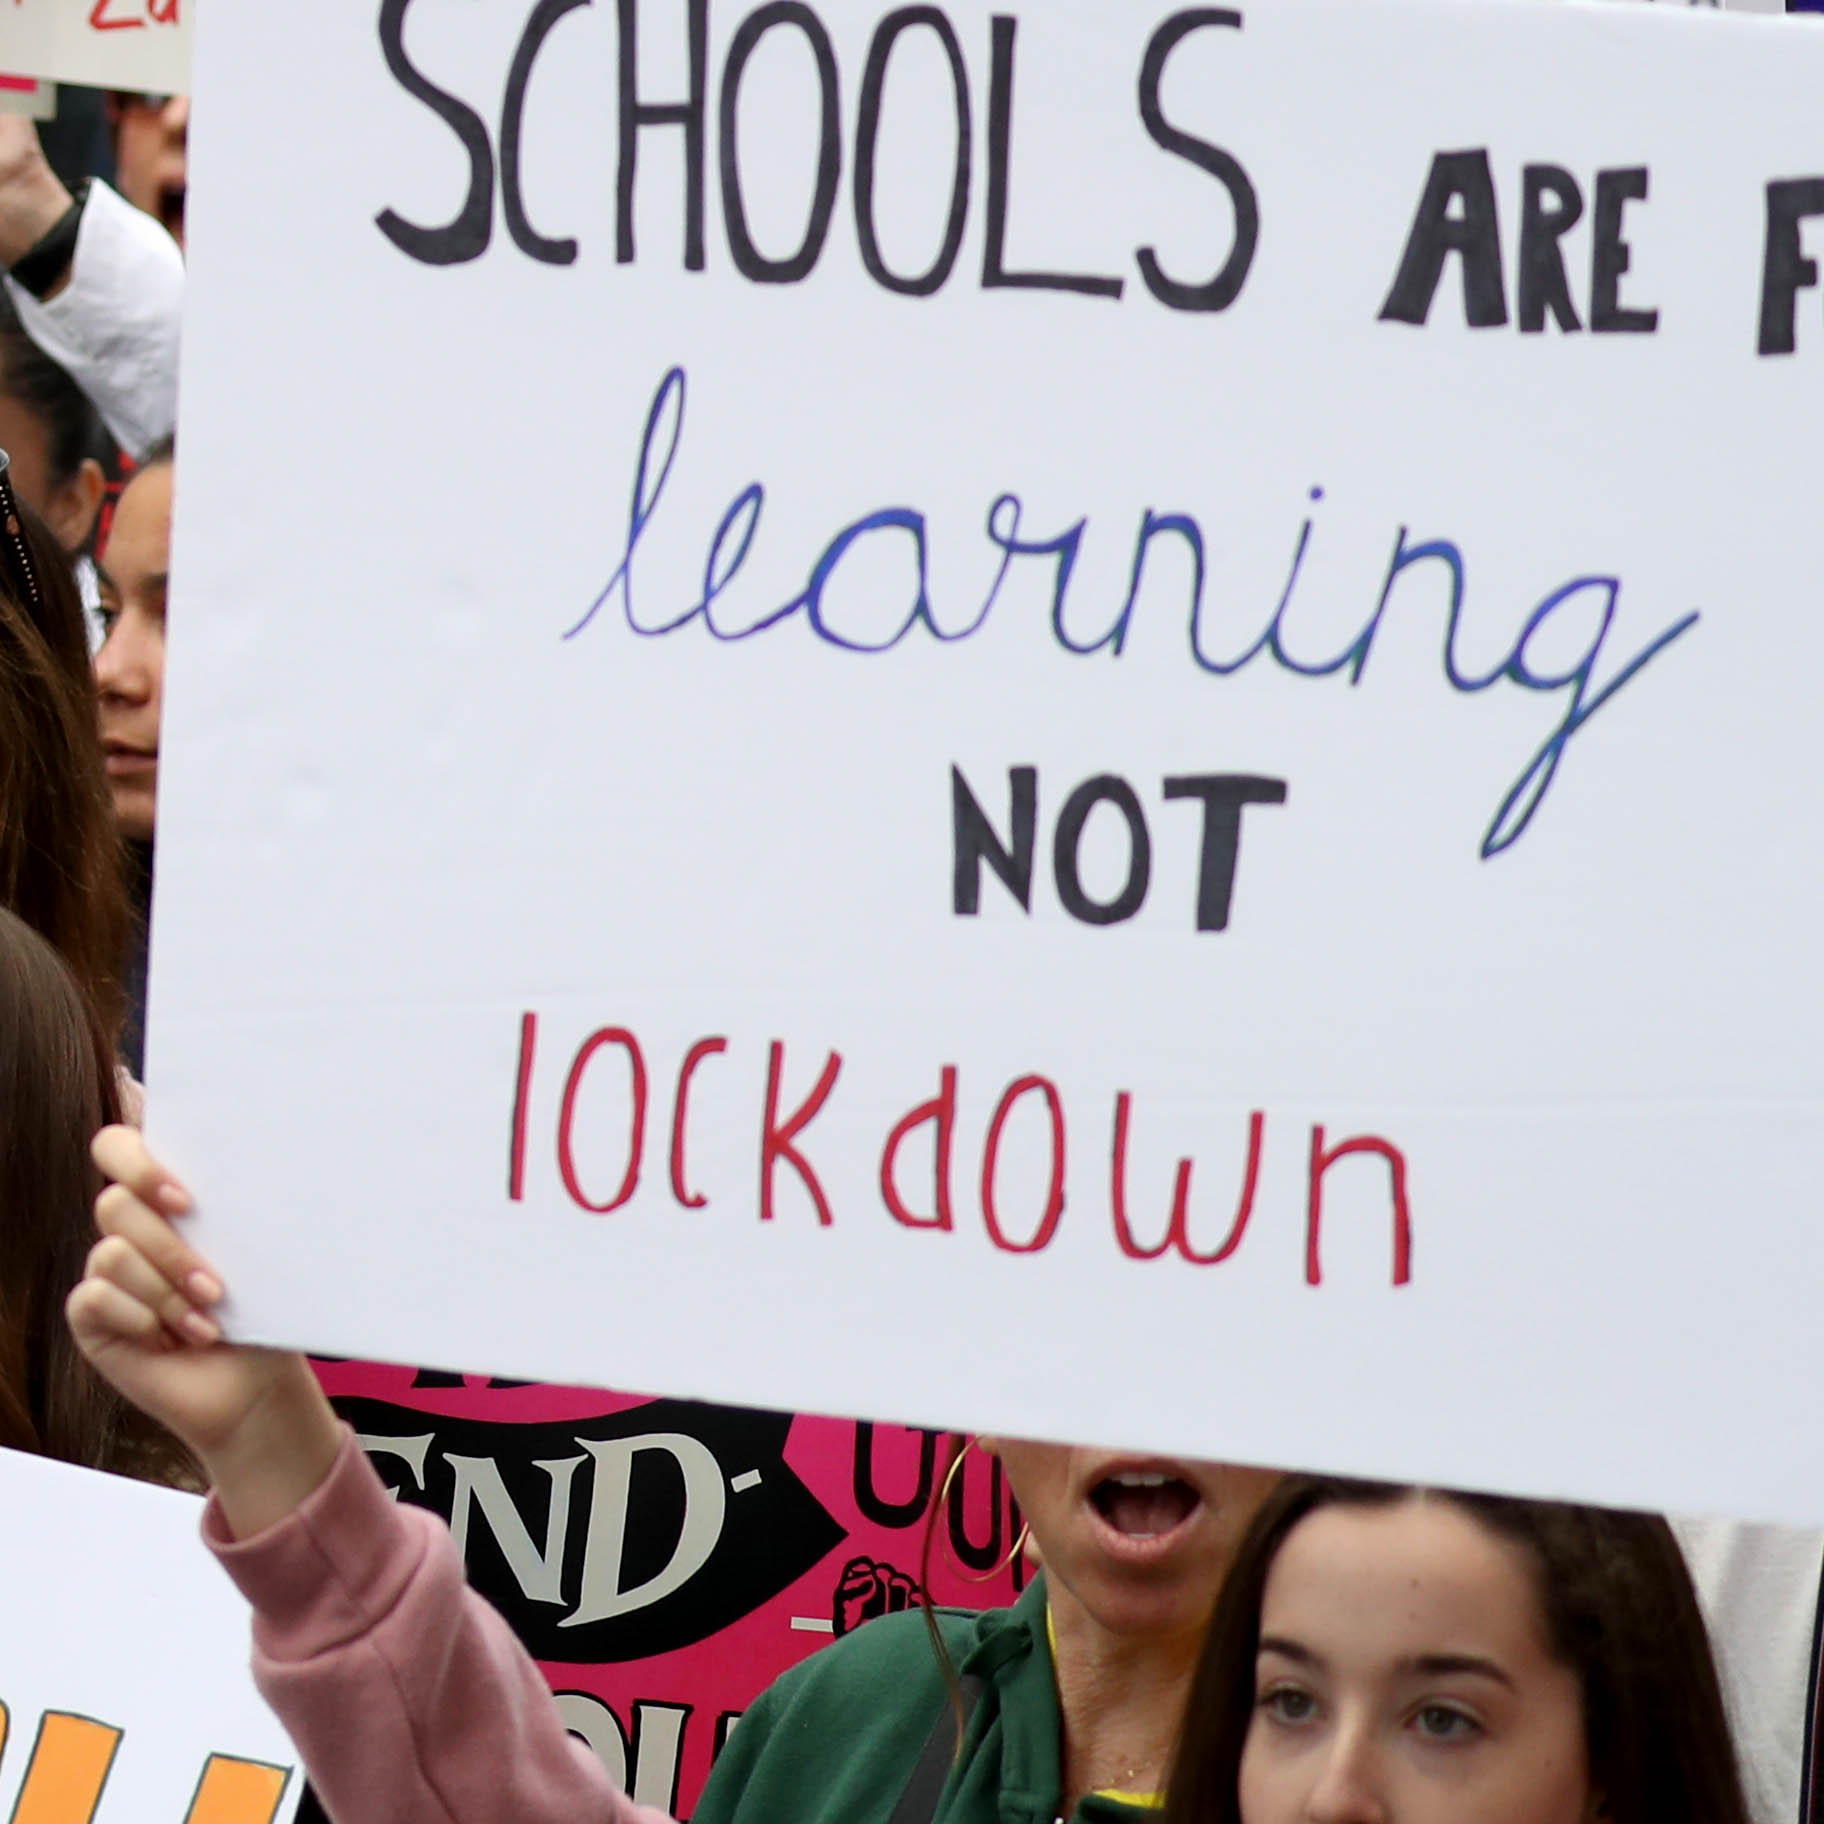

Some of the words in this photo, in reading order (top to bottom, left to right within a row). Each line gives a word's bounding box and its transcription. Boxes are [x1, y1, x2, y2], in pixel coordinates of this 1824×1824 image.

[1378, 148, 1659, 334] ARE
[563, 366, 1700, 859] learning
[951, 764, 1287, 932] NOT
[509, 1010, 1412, 1287] lockdown
